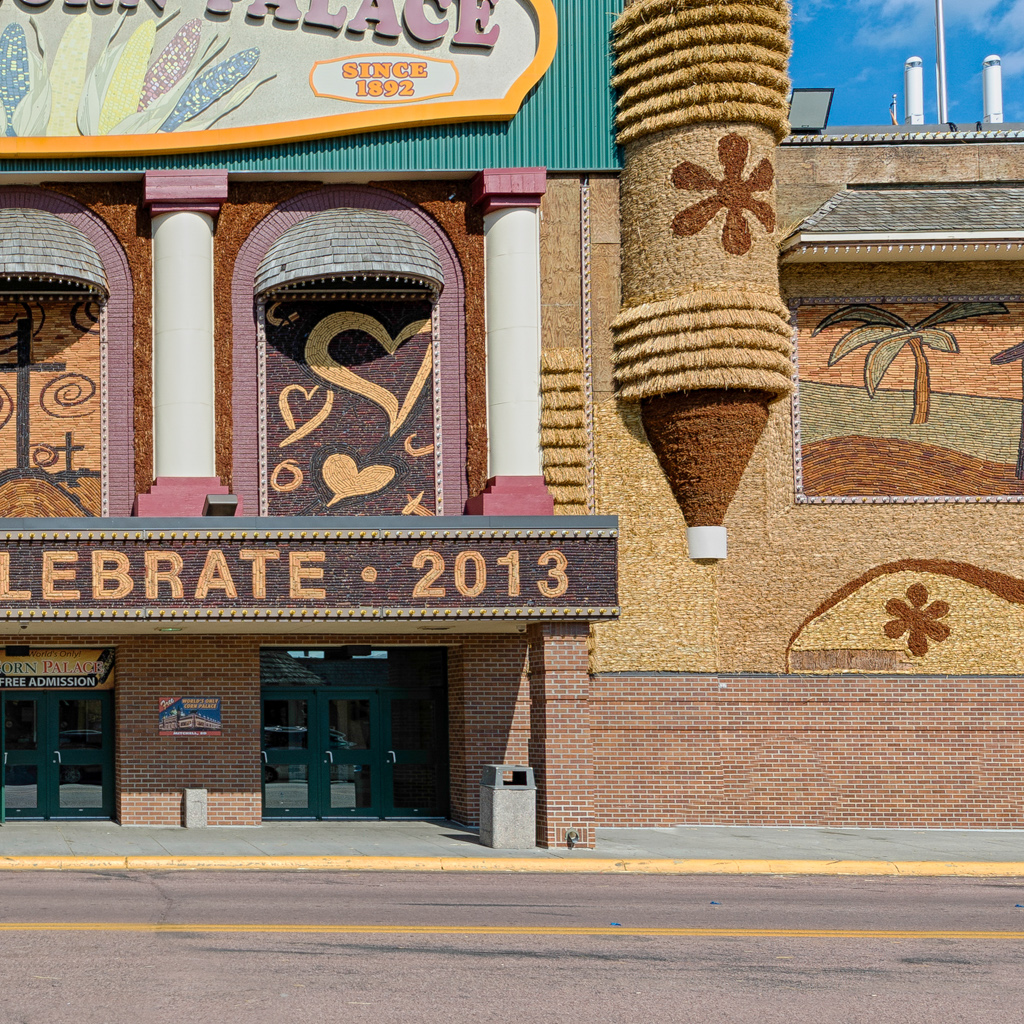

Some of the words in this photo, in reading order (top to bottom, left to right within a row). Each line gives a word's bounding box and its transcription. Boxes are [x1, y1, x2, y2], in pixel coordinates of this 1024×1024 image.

[342, 62, 428, 78] SINCE
[355, 80, 415, 97] 1892
[411, 549, 569, 599] 2013
[59, 650, 82, 659] Only!
[41, 660, 104, 675] PALACE
[28, 677, 96, 687] ADMISSION
[160, 698, 175, 711] Free
